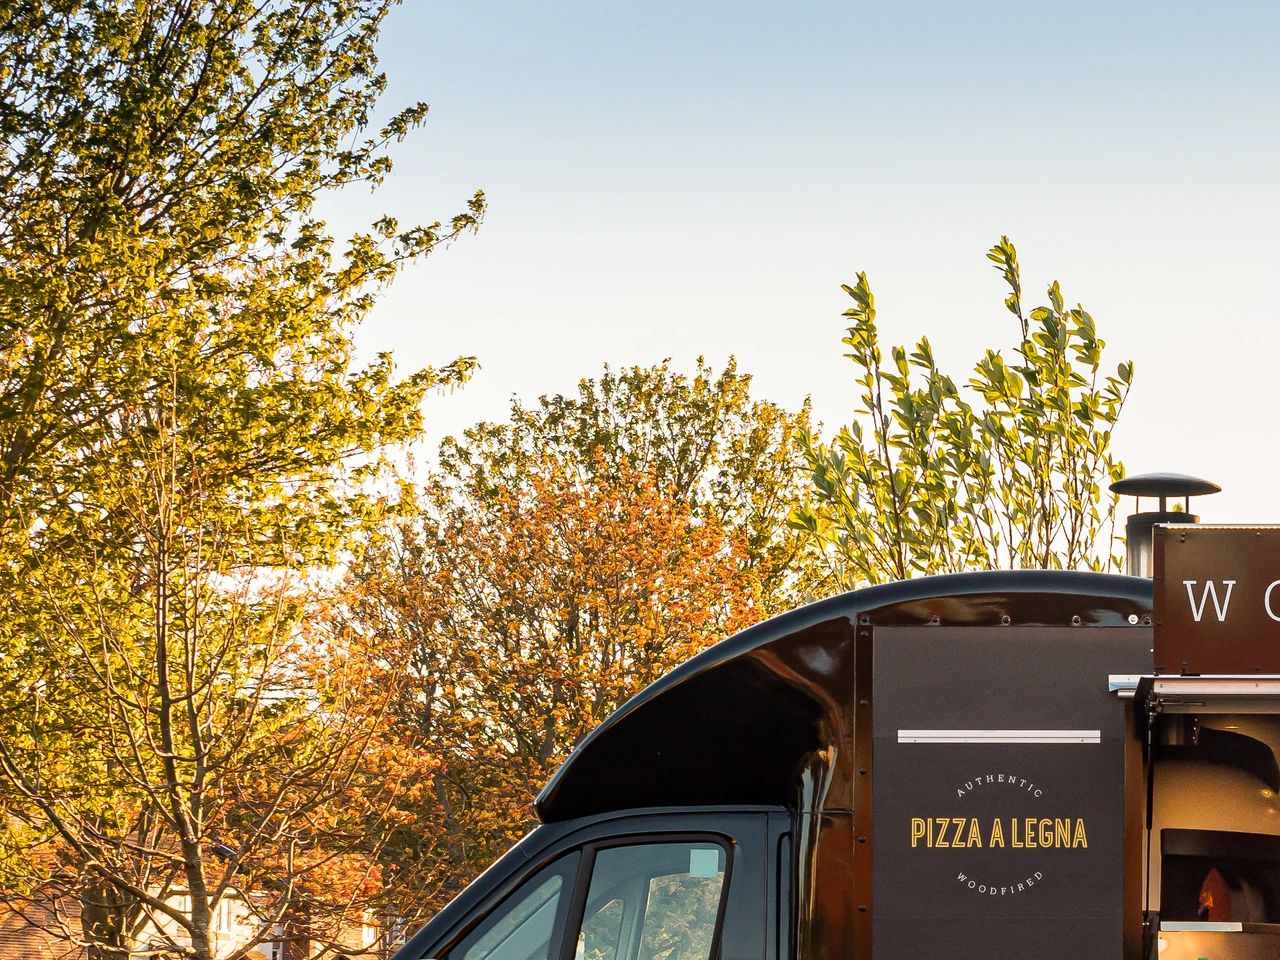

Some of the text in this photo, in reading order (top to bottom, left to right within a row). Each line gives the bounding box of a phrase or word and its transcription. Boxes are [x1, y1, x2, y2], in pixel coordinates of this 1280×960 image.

[956, 774, 1043, 798] AUTHENTIC
[911, 818, 1088, 848] PIZZA A LEGNA
[956, 871, 1043, 896] WOODFIRED
